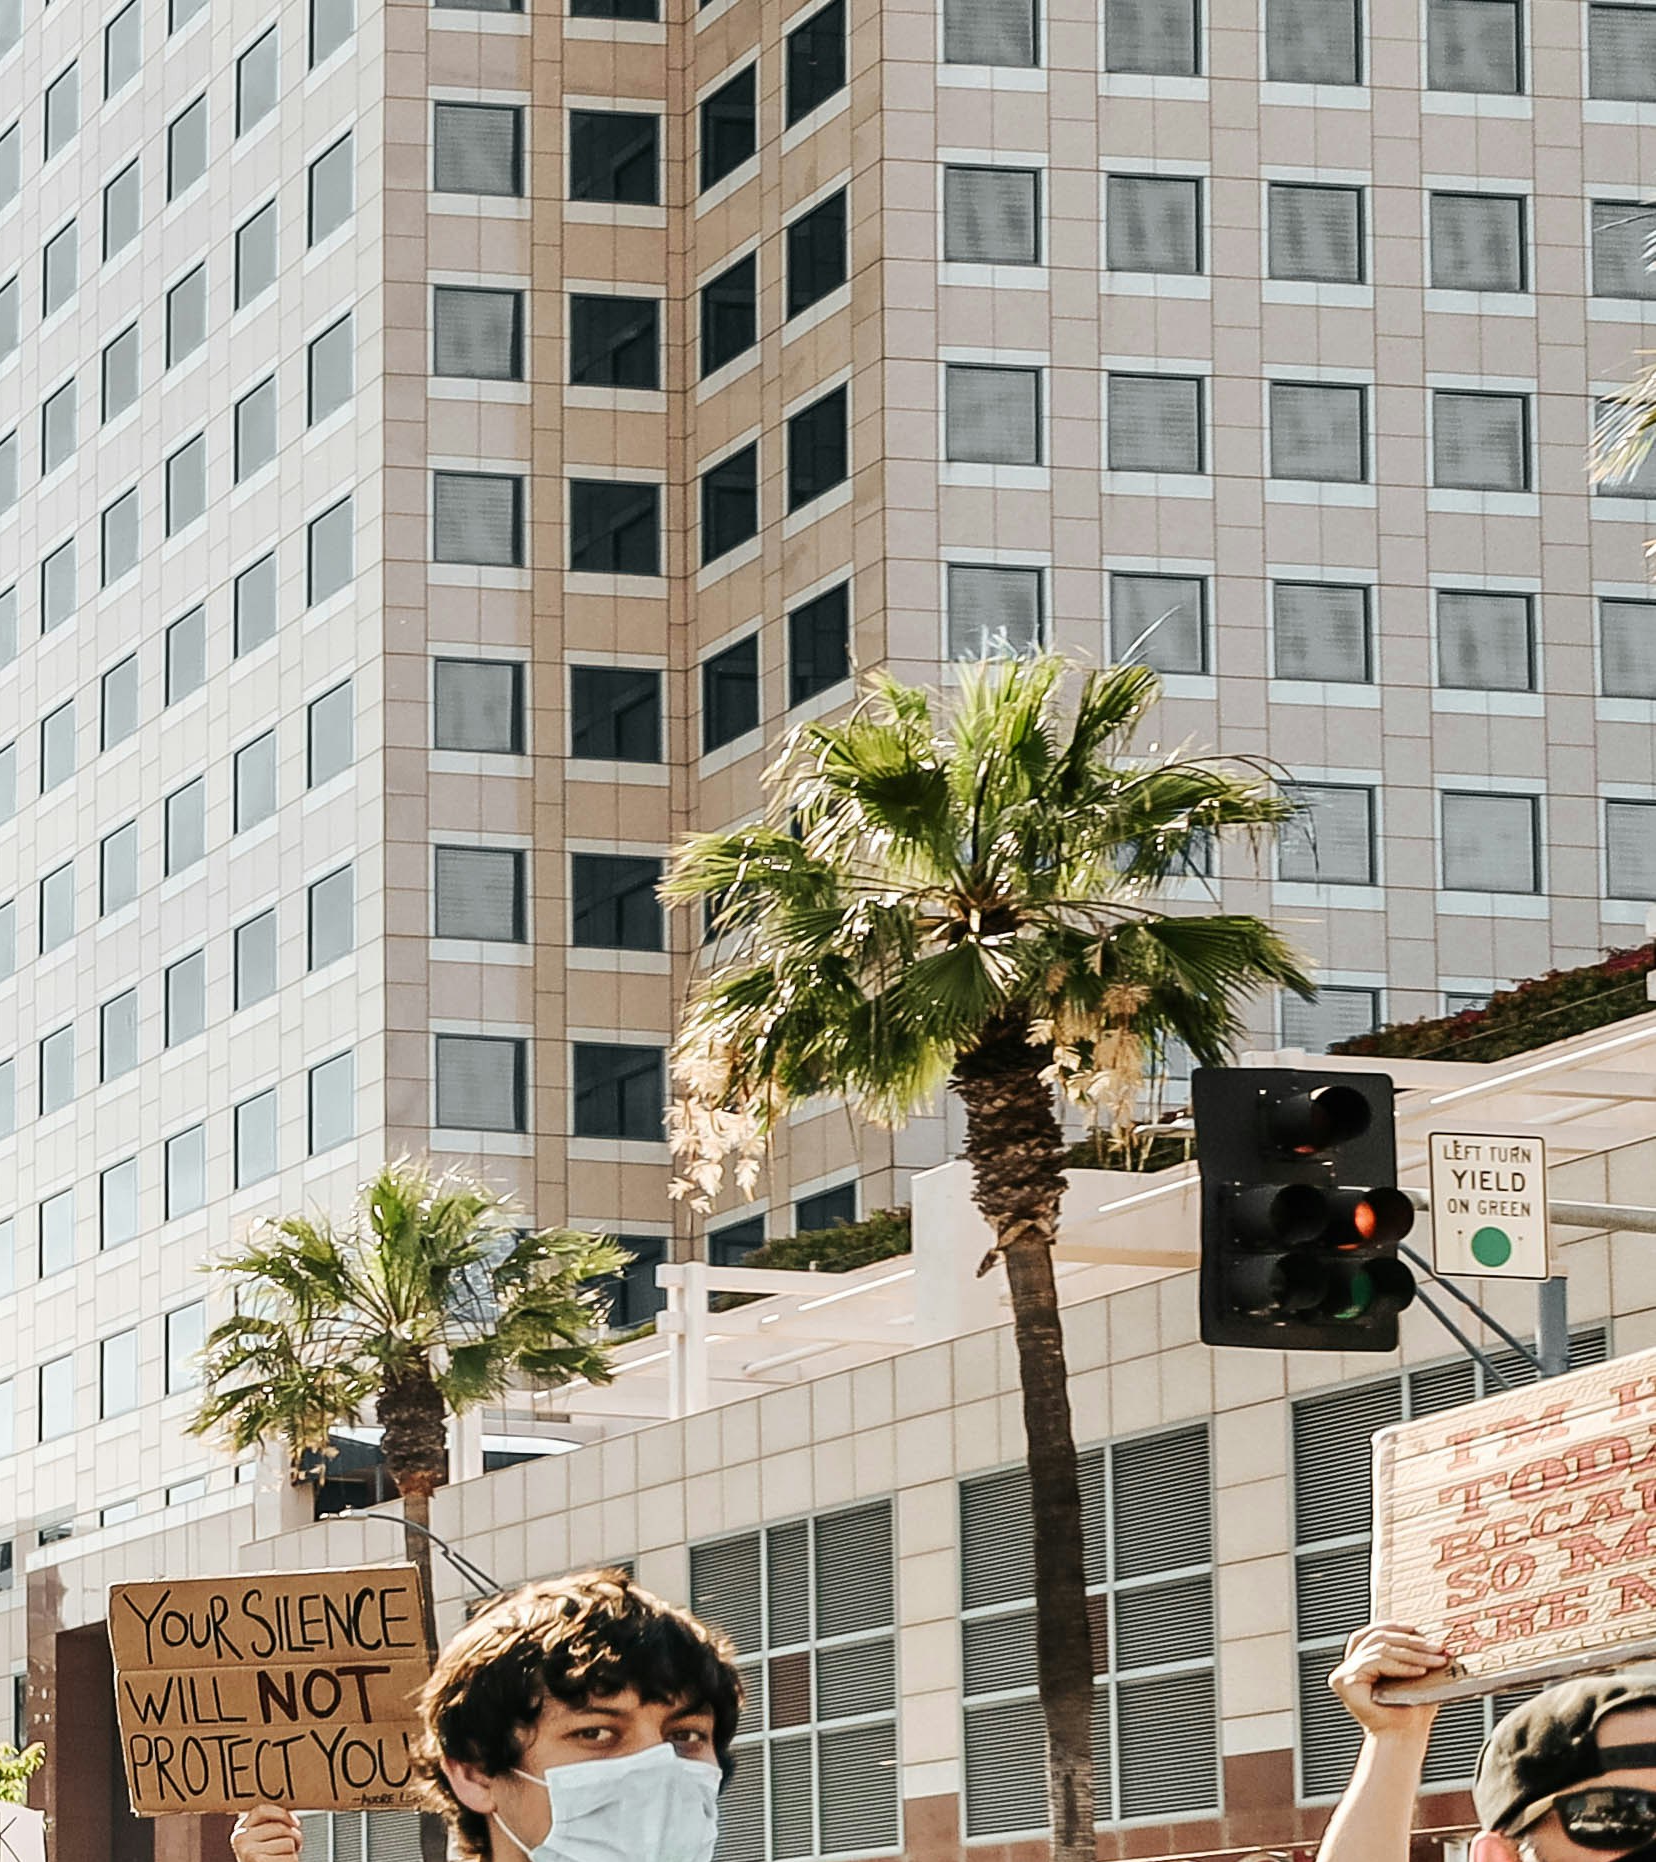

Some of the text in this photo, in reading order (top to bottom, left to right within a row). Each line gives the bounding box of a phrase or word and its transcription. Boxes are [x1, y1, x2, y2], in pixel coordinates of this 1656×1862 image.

[1443, 1143, 1531, 1163] LEFT TURN
[1452, 1169, 1525, 1192] YIELD
[1447, 1198, 1531, 1217] ON GREEN
[1446, 1553, 1536, 1609] SO
[123, 1587, 416, 1665] YOUR SILENCE
[125, 1665, 391, 1725] WILL NOT
[130, 1726, 413, 1801] PROTECT YOU
